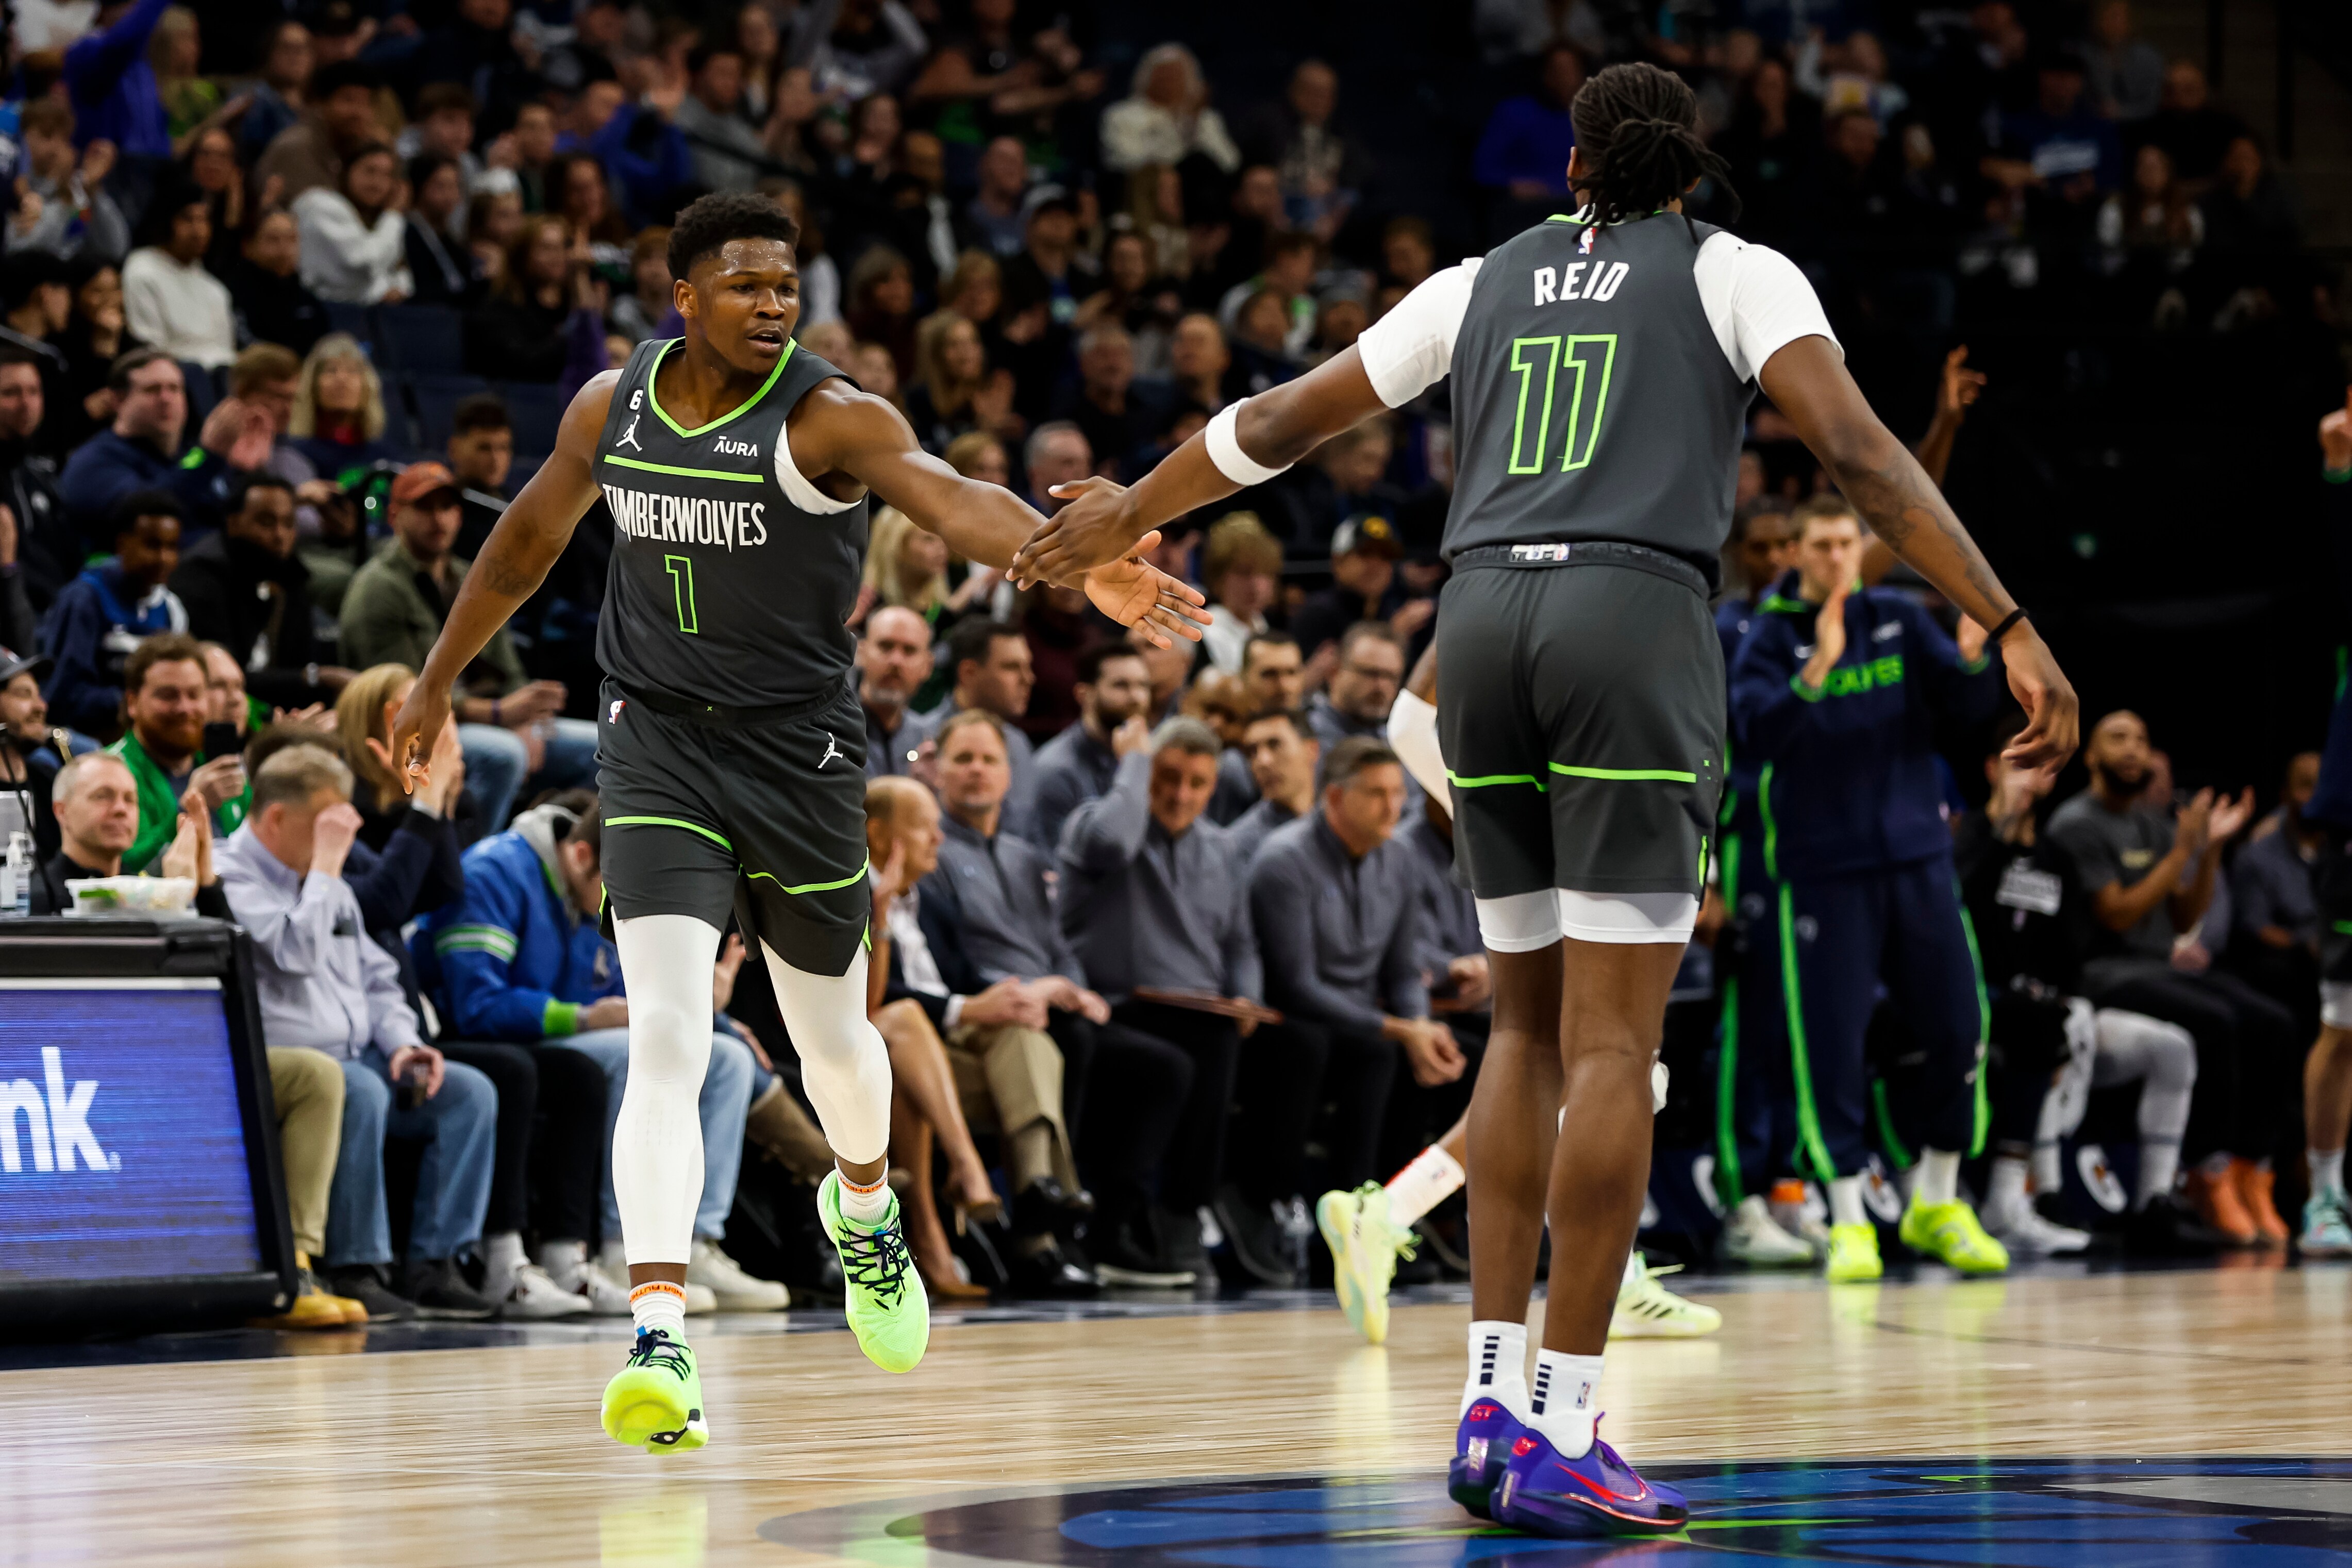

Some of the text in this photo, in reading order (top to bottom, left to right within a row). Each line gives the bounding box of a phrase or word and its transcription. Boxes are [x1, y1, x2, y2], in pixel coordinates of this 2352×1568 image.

[1533, 261, 1629, 306] REID
[629, 390, 643, 410] 6
[1507, 333, 1617, 474] 11
[602, 483, 767, 553] TIMBERWOLVES
[664, 554, 698, 633] 1
[1825, 654, 1903, 696] OLVES
